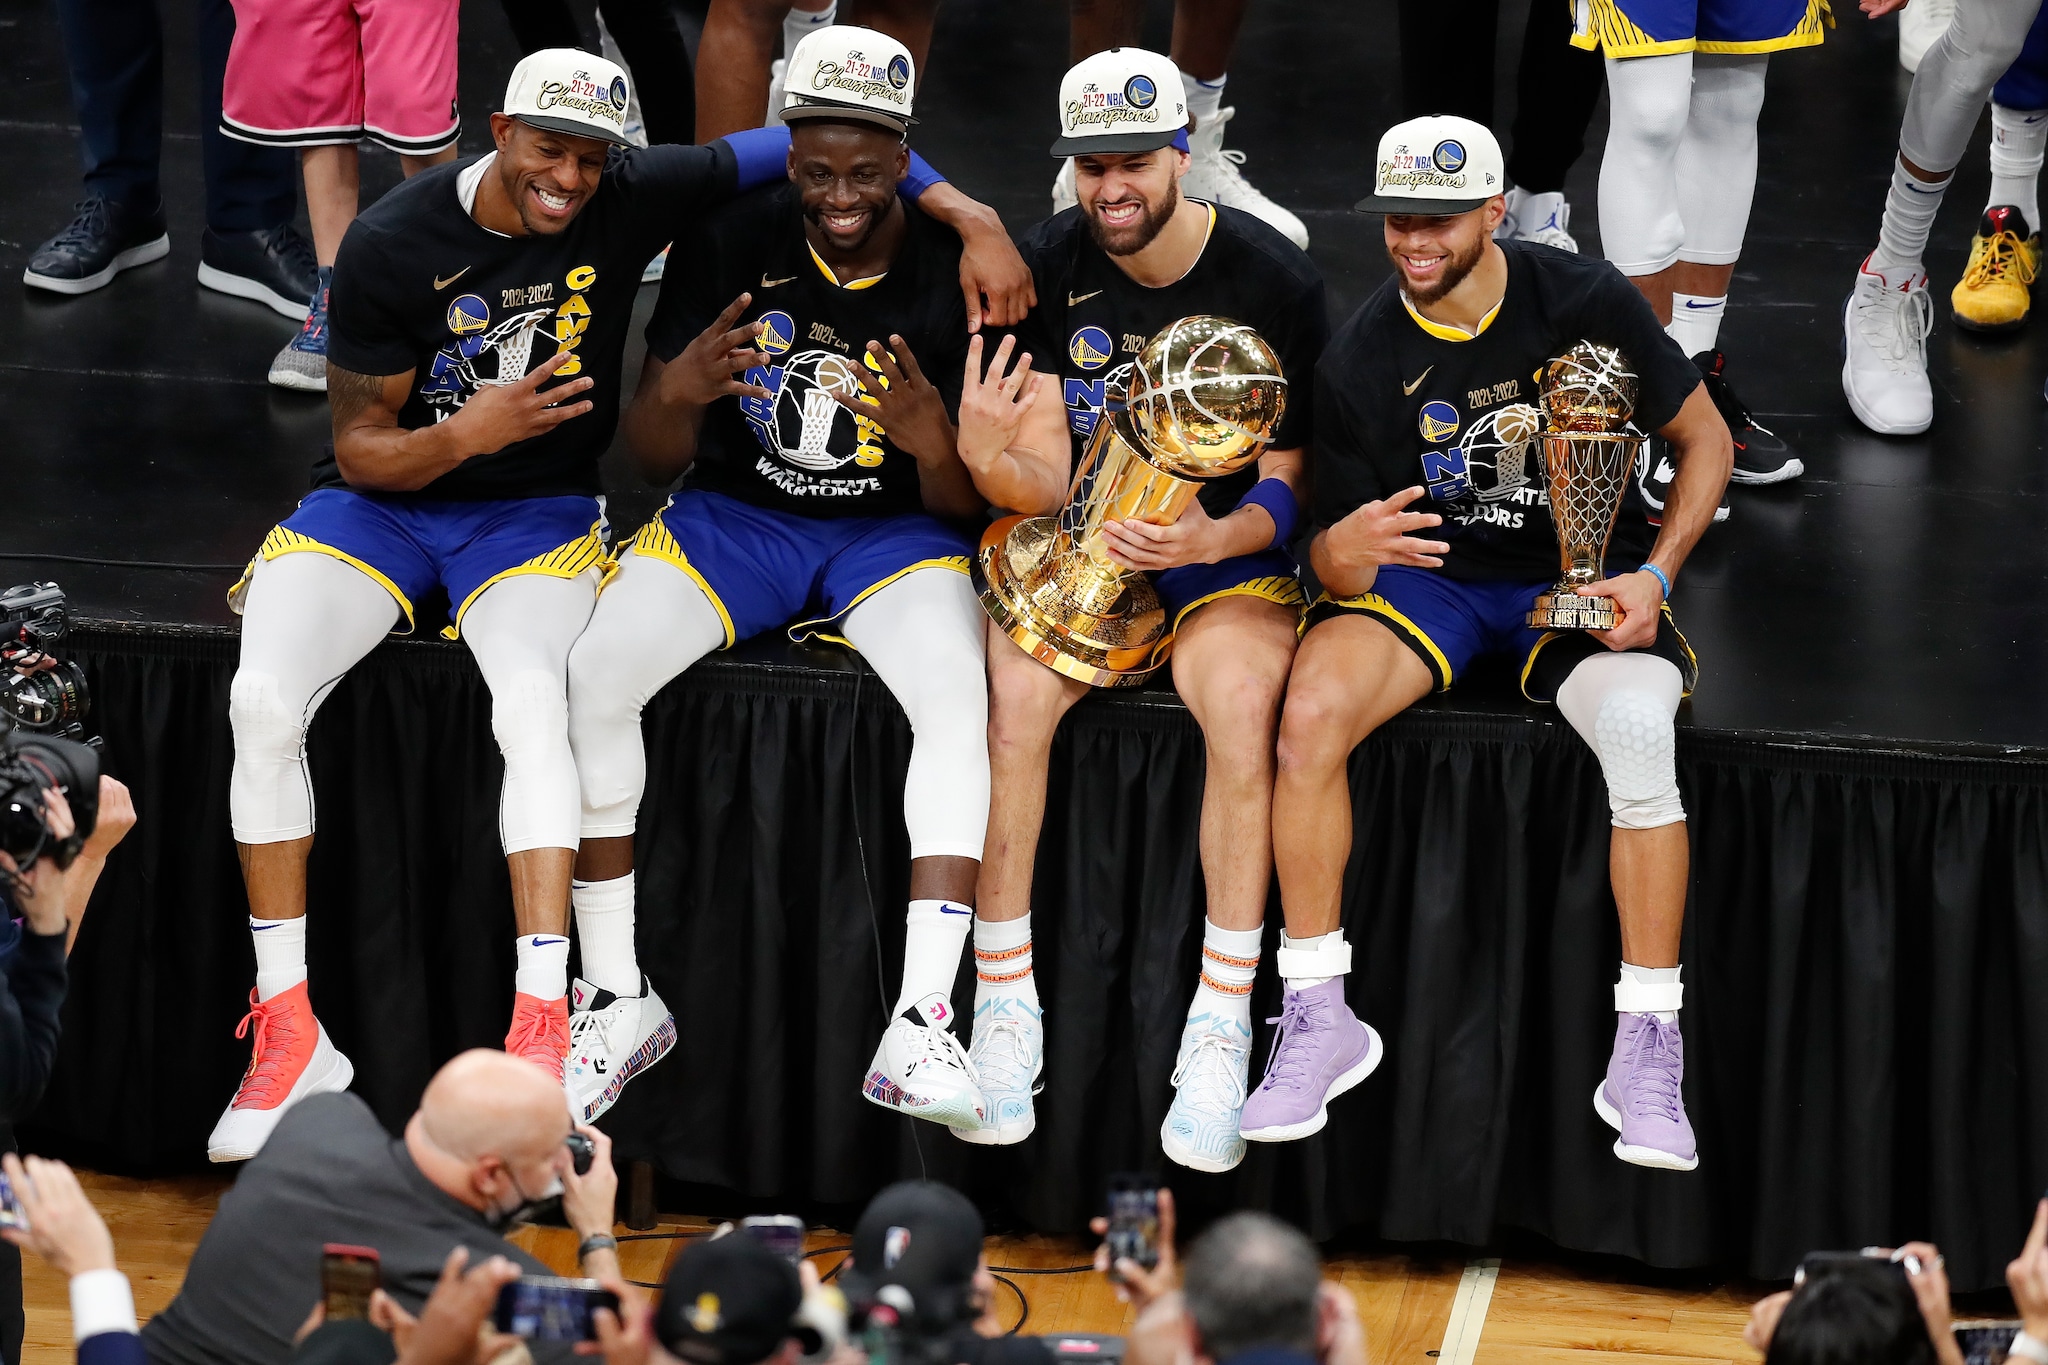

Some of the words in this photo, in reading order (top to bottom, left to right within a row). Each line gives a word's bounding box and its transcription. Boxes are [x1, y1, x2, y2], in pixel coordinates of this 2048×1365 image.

[847, 50, 866, 62] The
[573, 70, 591, 81] The
[845, 60, 870, 78] 21-22
[871, 66, 886, 81] NBA
[571, 79, 595, 97] 21-22
[596, 85, 609, 101] NBA
[811, 60, 906, 105] Champions
[1082, 83, 1098, 93] The
[536, 80, 625, 126] Champions
[1083, 93, 1105, 107] 21-22
[1106, 93, 1124, 106] NBA
[1065, 100, 1160, 131] Champions
[1394, 145, 1409, 155] The
[1393, 155, 1414, 169] 21-22
[1414, 156, 1432, 169] NBA
[1379, 160, 1467, 191] Champions
[502, 282, 554, 308] 2021-2022
[1467, 379, 1521, 409] 2021-2022
[1554, 611, 1578, 625] MOST
[1579, 612, 1616, 627] VALUABL
